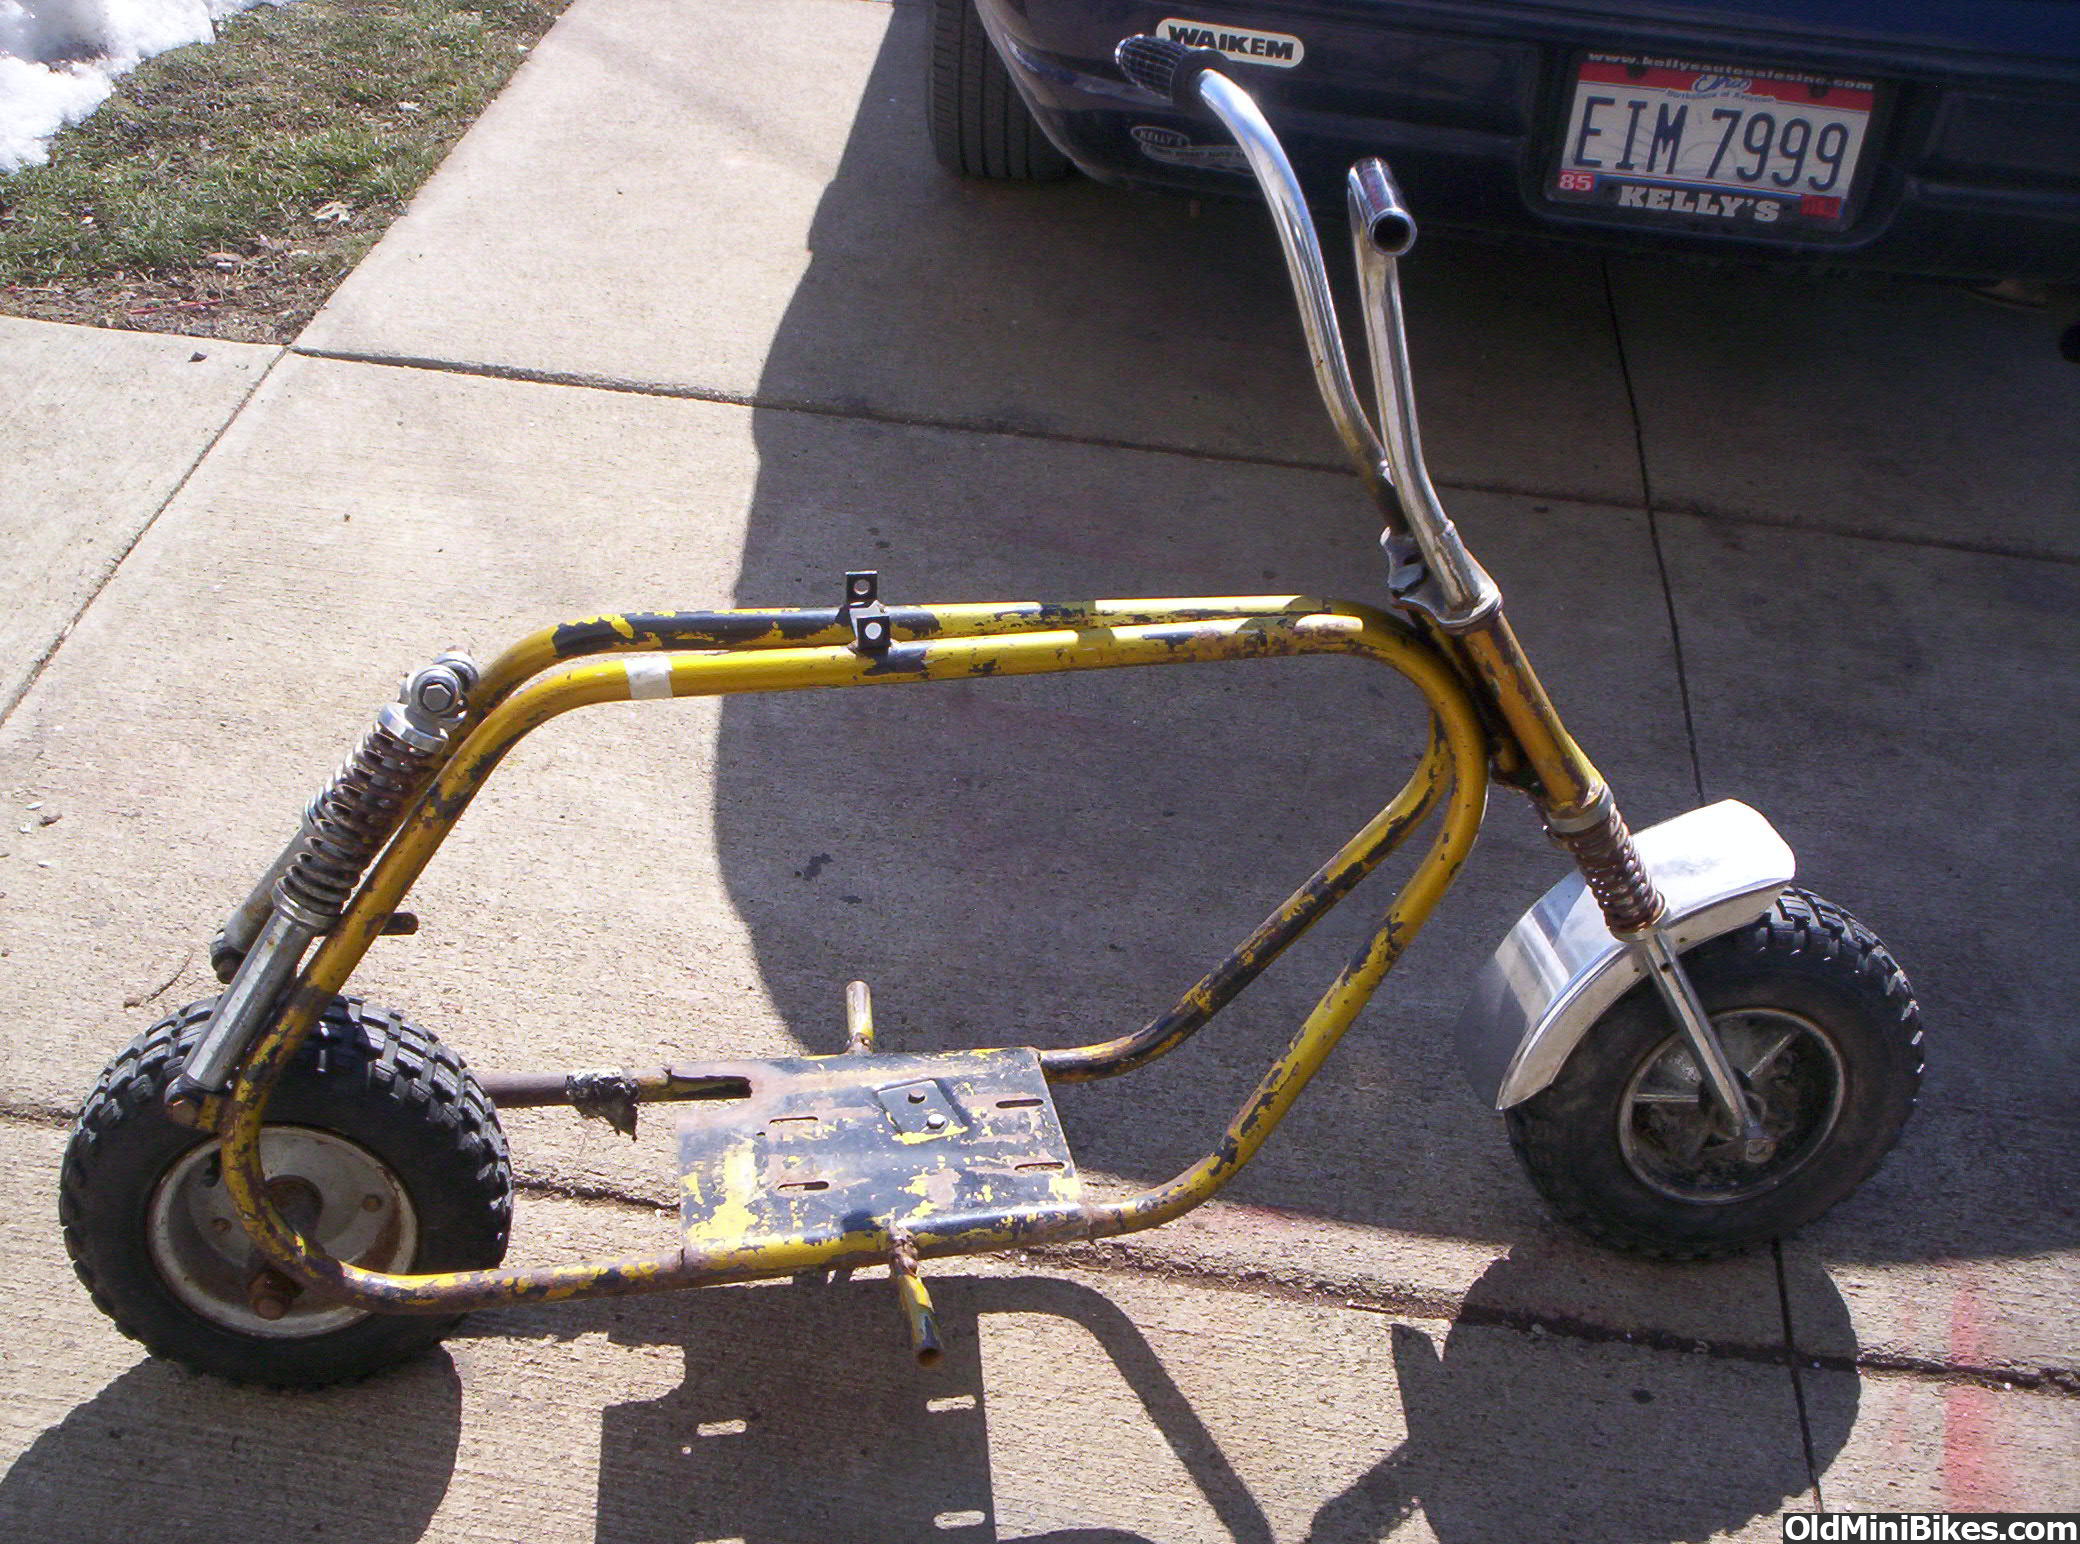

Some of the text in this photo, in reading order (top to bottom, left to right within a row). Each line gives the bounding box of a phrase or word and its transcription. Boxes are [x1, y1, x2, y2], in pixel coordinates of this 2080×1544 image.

[1168, 25, 1294, 60] WAIKEM
[1573, 96, 1850, 192] EIM 7999
[1560, 173, 1593, 192] 85
[1618, 185, 1781, 222] KELLY'S
